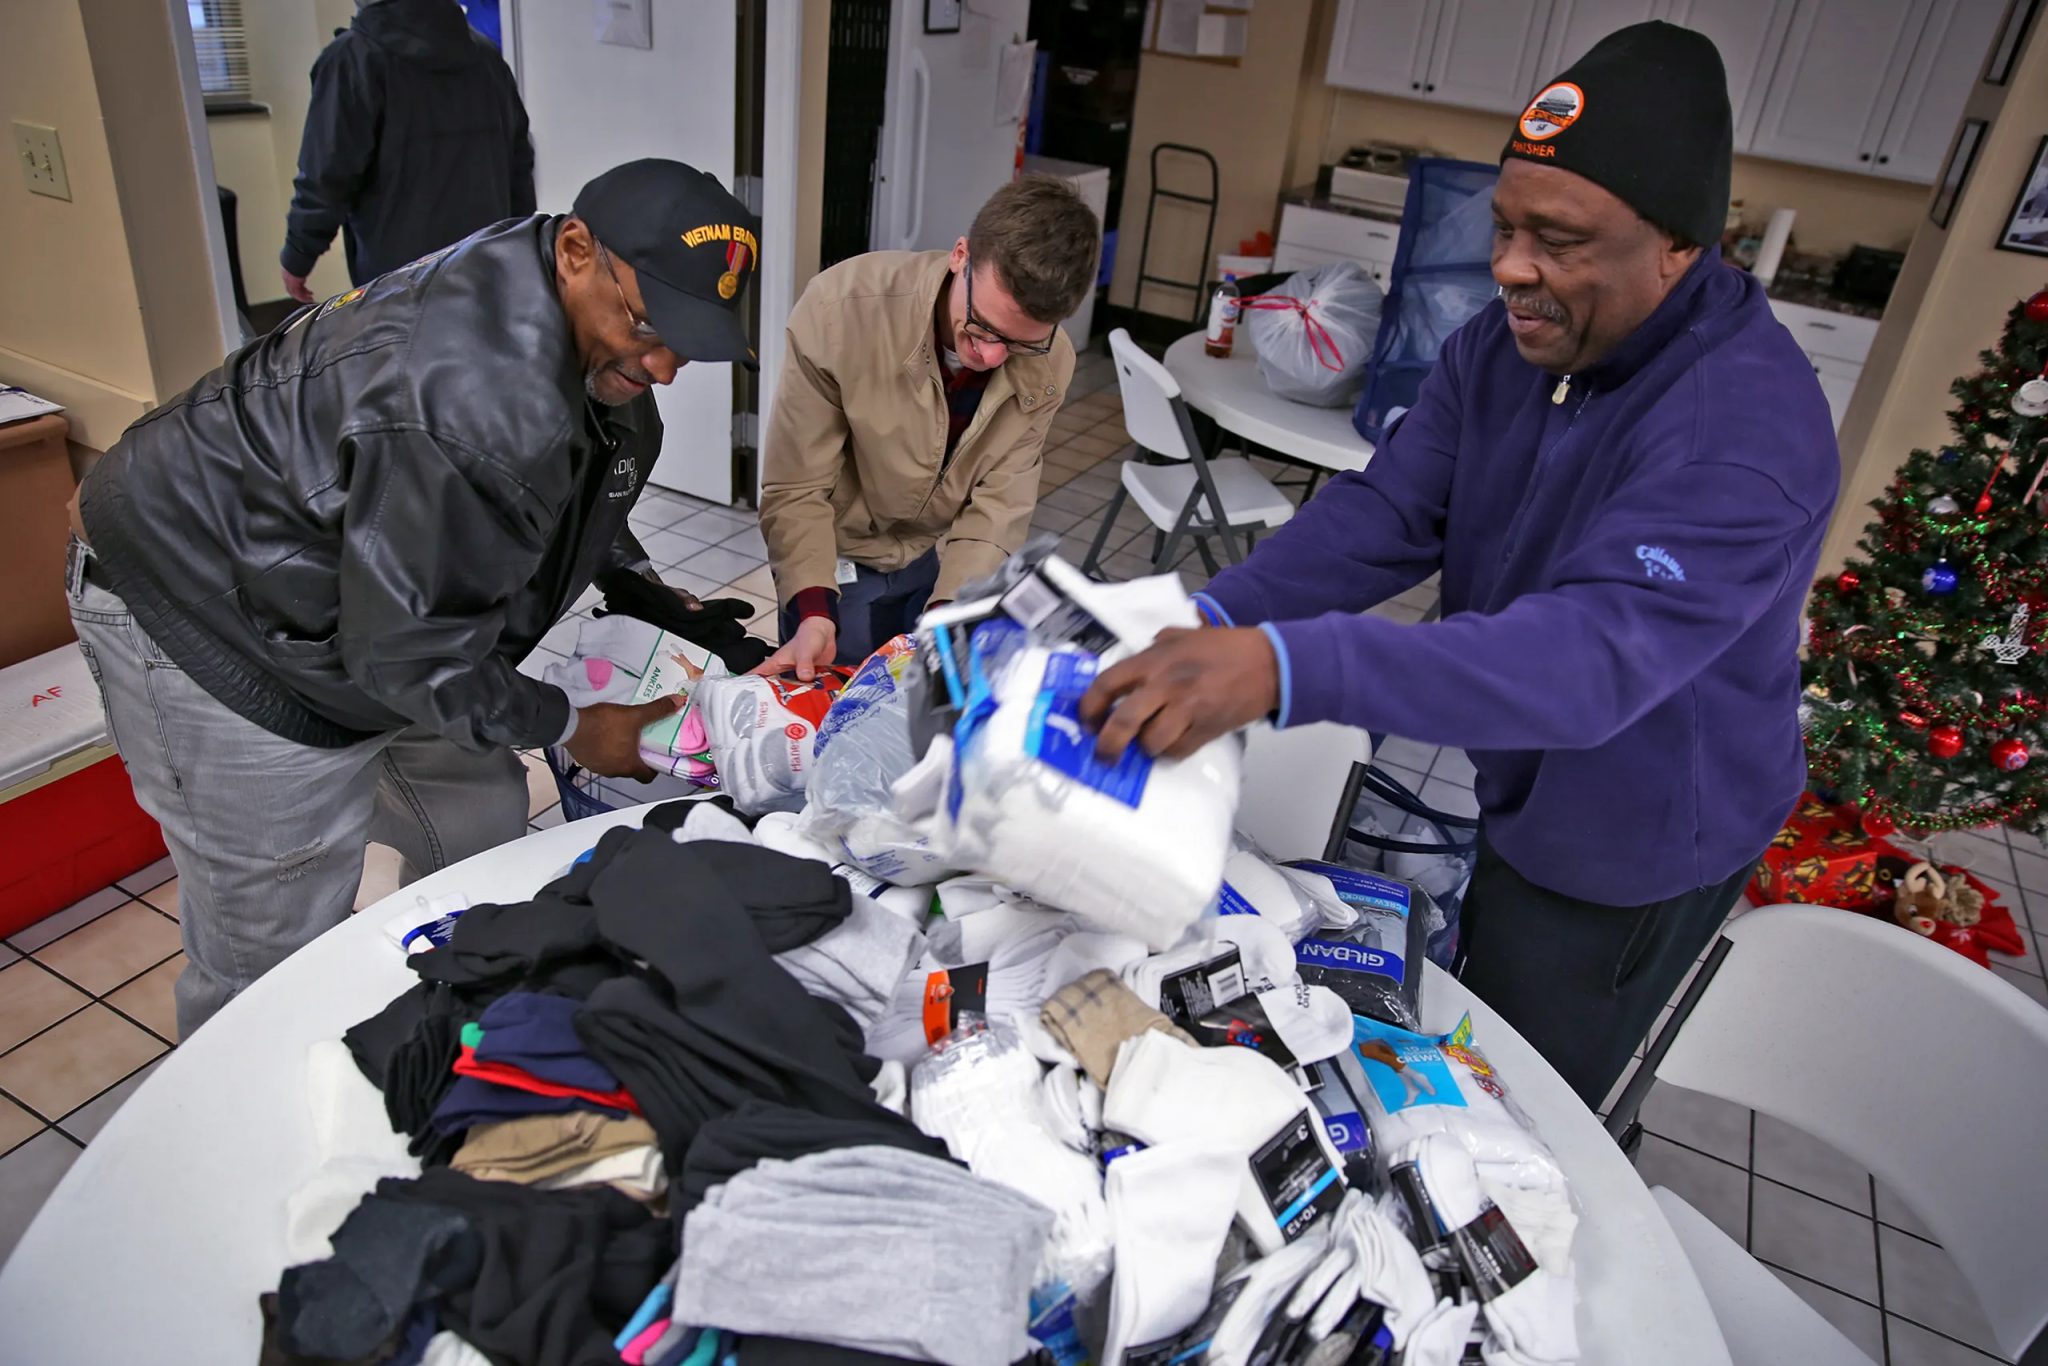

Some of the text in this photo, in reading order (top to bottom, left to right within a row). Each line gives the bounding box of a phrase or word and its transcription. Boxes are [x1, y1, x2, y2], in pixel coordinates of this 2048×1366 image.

[1512, 141, 1555, 157] FINISHER
[680, 223, 731, 248] VIETNAM
[614, 457, 635, 475] DIO
[643, 666, 661, 698] ANKLES
[755, 701, 768, 728] Hanes
[1340, 892, 1402, 911] CREW SOCKS
[1302, 943, 1385, 967] GILDAN
[1396, 1054, 1441, 1063] CREWS
[1297, 1124, 1309, 1141] 3
[1286, 1204, 1317, 1235] 10-13
